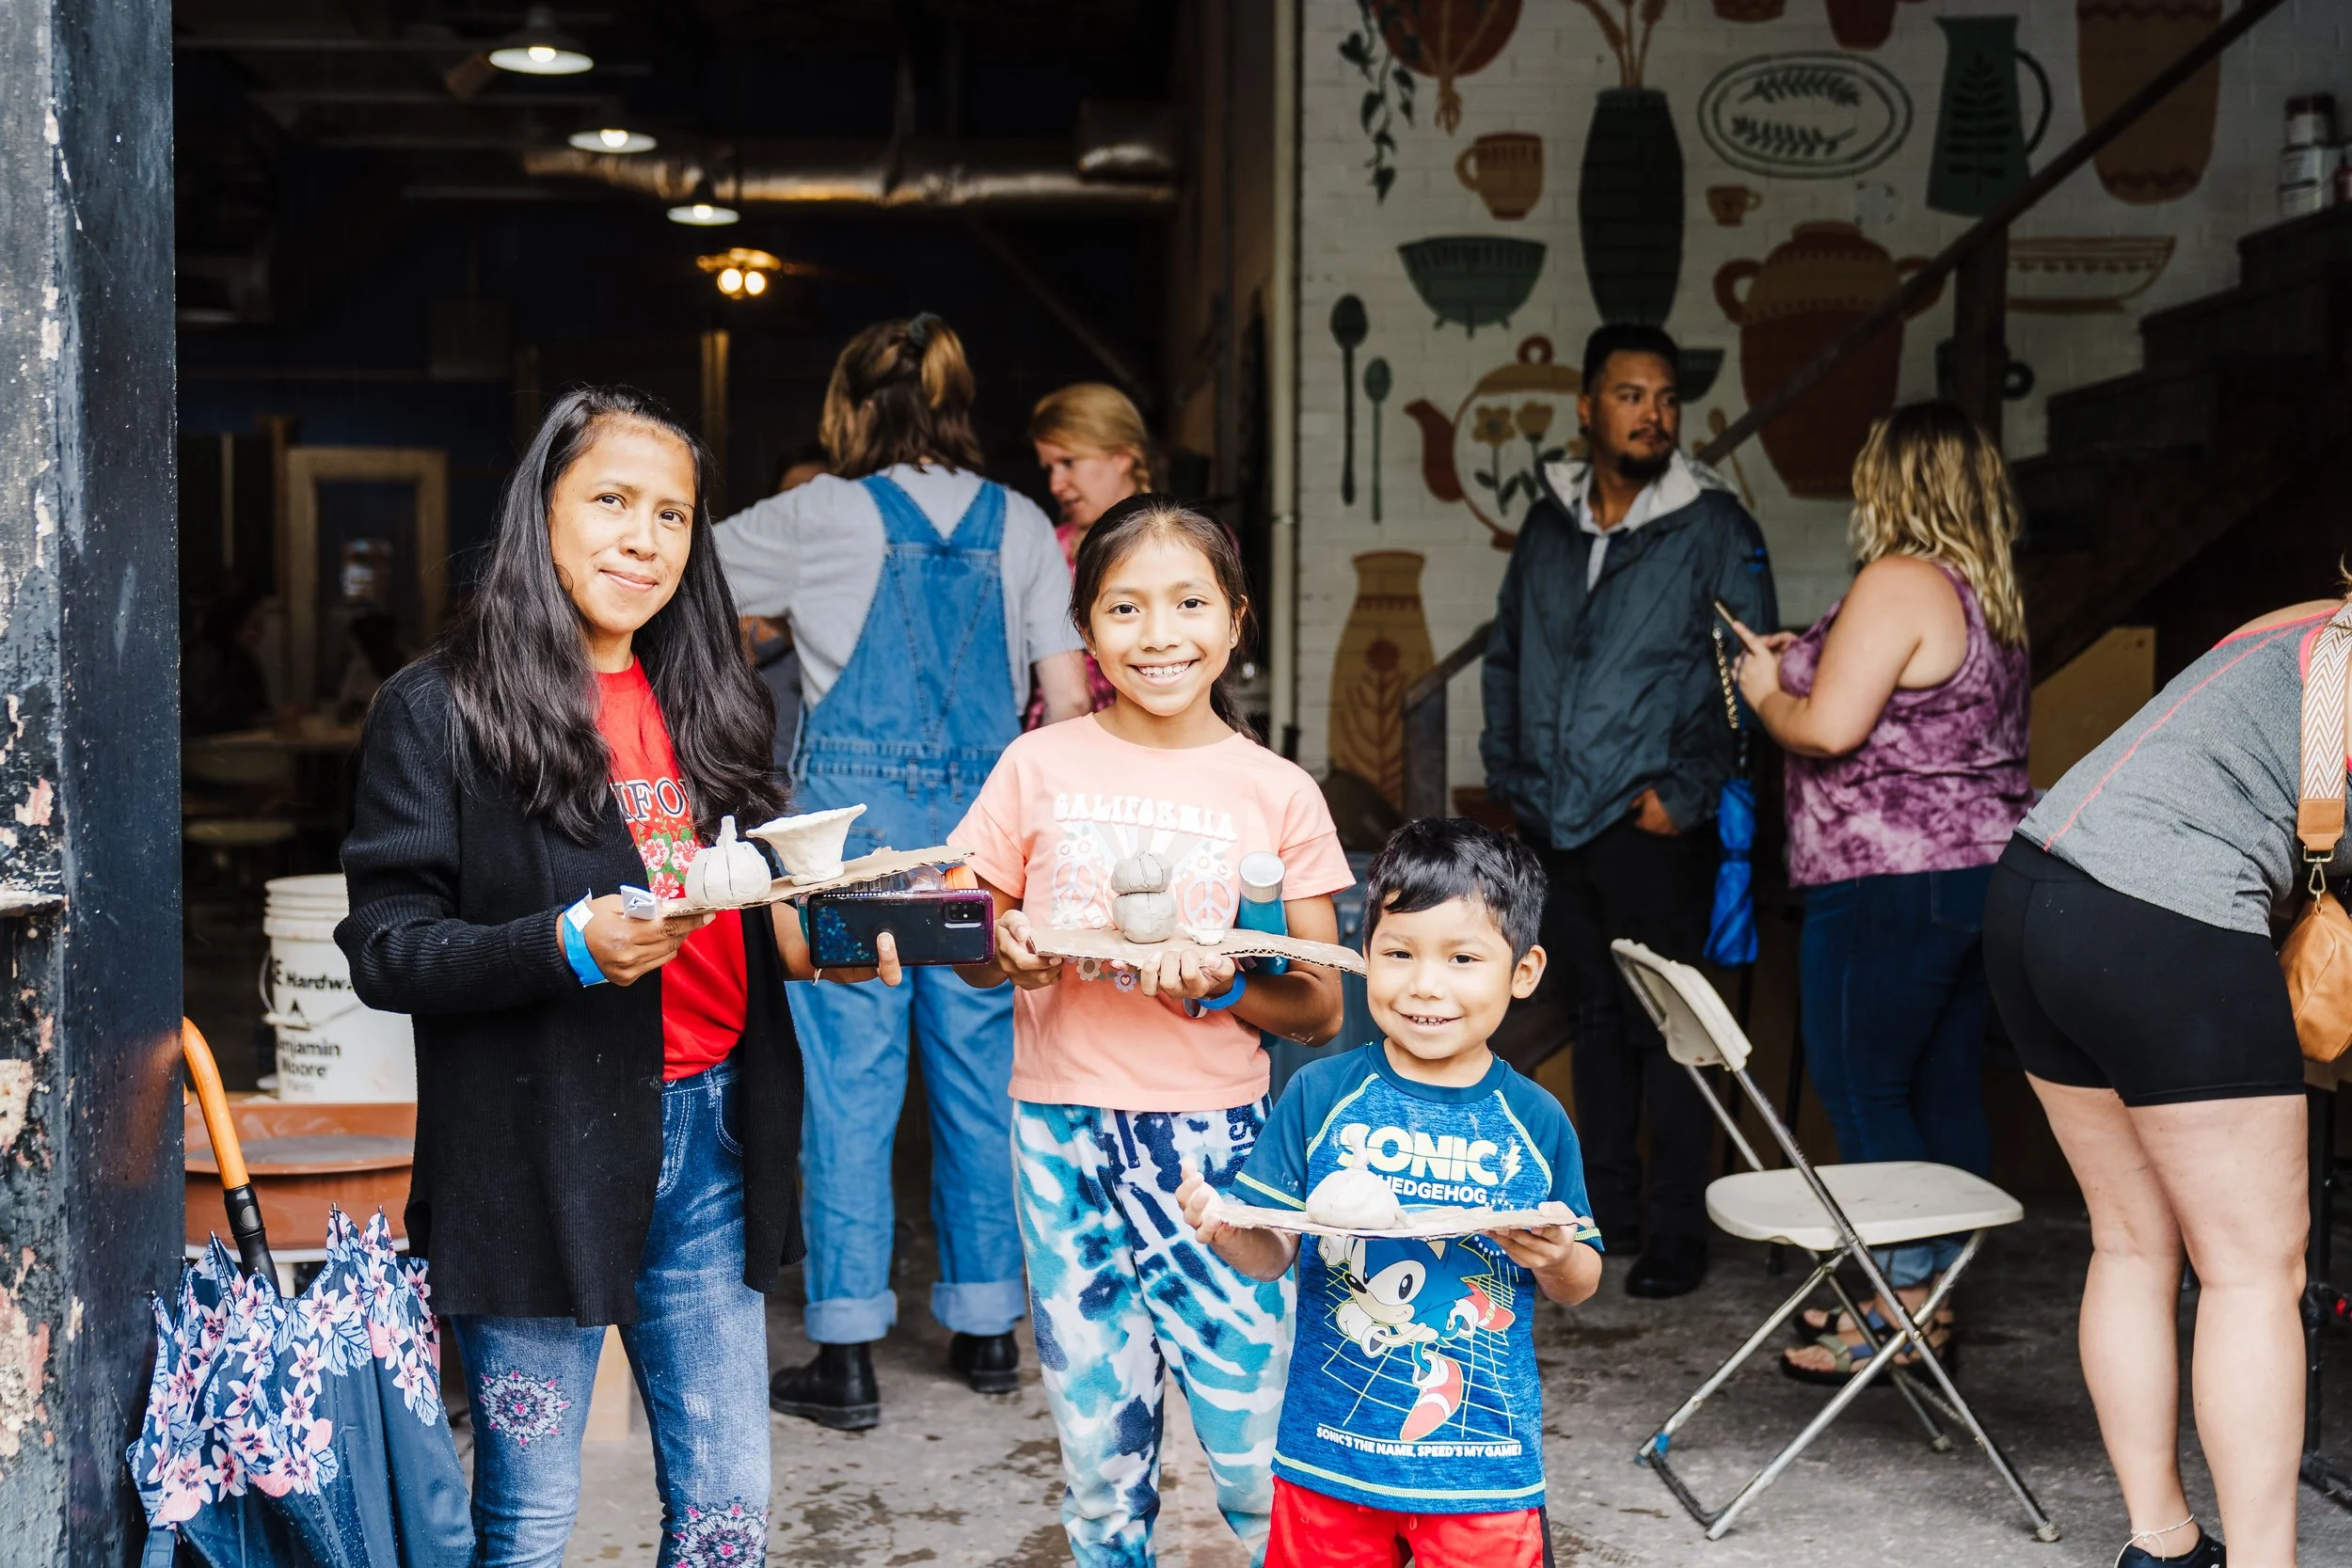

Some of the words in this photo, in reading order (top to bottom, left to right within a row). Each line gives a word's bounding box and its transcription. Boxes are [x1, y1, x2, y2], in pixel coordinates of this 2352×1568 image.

[610, 777, 687, 822] IFO
[1054, 793, 1237, 842] CALIFORNIA
[1336, 1123, 1499, 1186] SONIC
[1316, 1427, 1353, 1448] SONIC'S
[1354, 1437, 1375, 1453] THE
[1376, 1442, 1417, 1458] NAME,
[1418, 1445, 1463, 1457] SPEED'S
[1464, 1445, 1484, 1457] MY
[1485, 1444, 1522, 1457] GAME!
